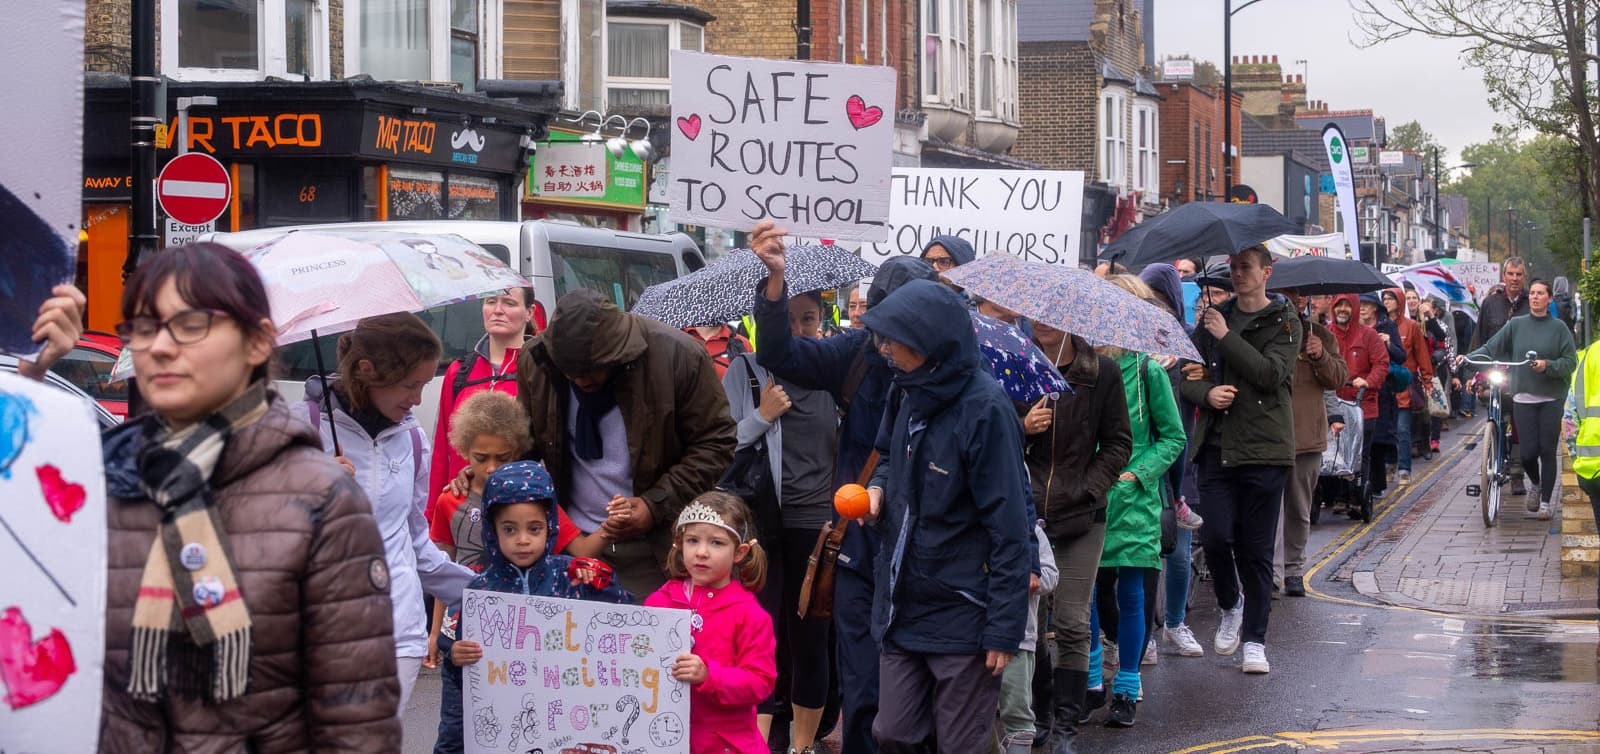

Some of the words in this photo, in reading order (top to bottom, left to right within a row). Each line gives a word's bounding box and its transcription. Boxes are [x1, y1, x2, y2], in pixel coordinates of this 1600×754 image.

[706, 64, 830, 124] SAFE
[221, 113, 322, 149] TACO
[375, 115, 400, 154] MR
[402, 119, 437, 154] TACO
[708, 128, 859, 185] ROUTES
[84, 177, 122, 188] AWAY
[299, 185, 316, 203] 68
[677, 178, 727, 213] TO
[741, 185, 884, 226] SCHOOL
[891, 174, 981, 210] HANK
[1000, 177, 1062, 212] YOU
[171, 223, 210, 234] Except
[872, 224, 1069, 265] COUILLORS!
[290, 257, 347, 276] PRINCESS
[478, 603, 580, 652] What
[598, 633, 655, 658] are
[487, 659, 527, 687] we
[543, 657, 660, 714] waiting
